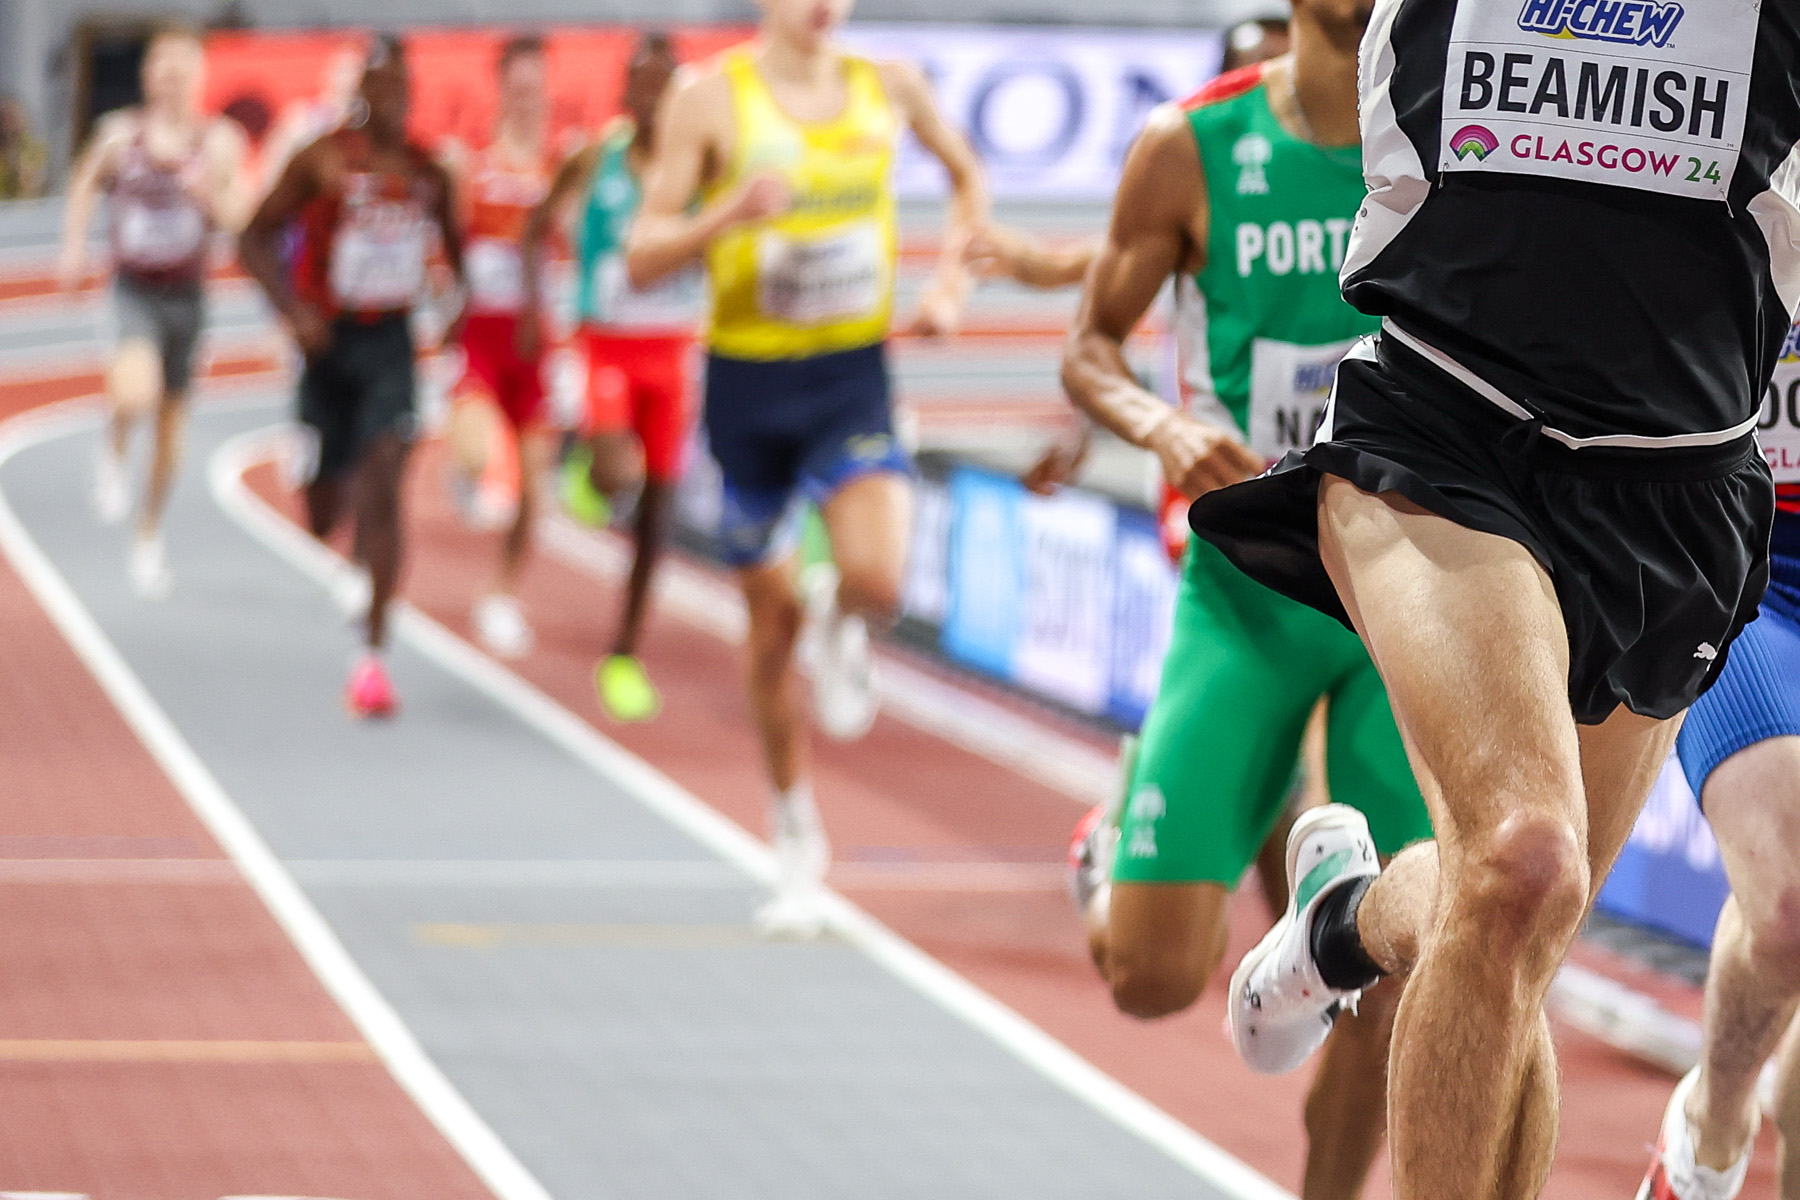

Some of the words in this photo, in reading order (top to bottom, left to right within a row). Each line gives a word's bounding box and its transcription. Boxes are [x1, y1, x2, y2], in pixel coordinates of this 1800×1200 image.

[1459, 51, 1729, 140] BEAMISH
[1510, 134, 1680, 178] GLASGOW
[1684, 156, 1722, 185] 24
